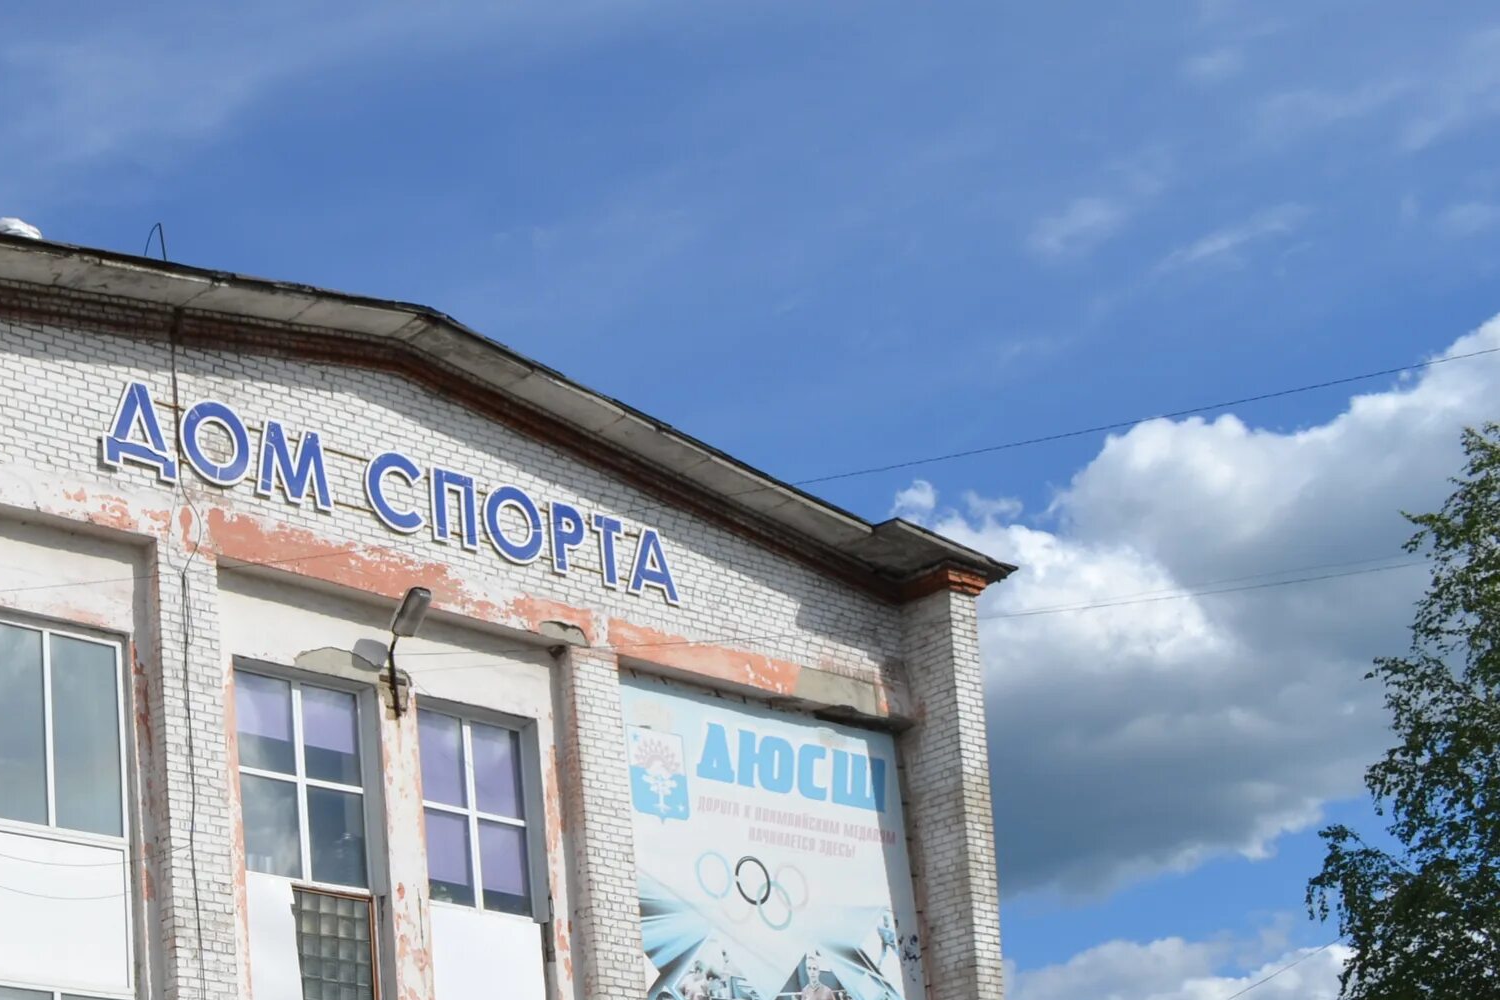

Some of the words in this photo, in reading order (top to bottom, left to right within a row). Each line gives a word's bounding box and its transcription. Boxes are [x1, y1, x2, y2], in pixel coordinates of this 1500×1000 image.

[102, 380, 334, 512] ДОМ
[363, 451, 681, 606] СПОРТА
[696, 721, 887, 813] ДЮСШ
[697, 796, 740, 817] ДОРОГА
